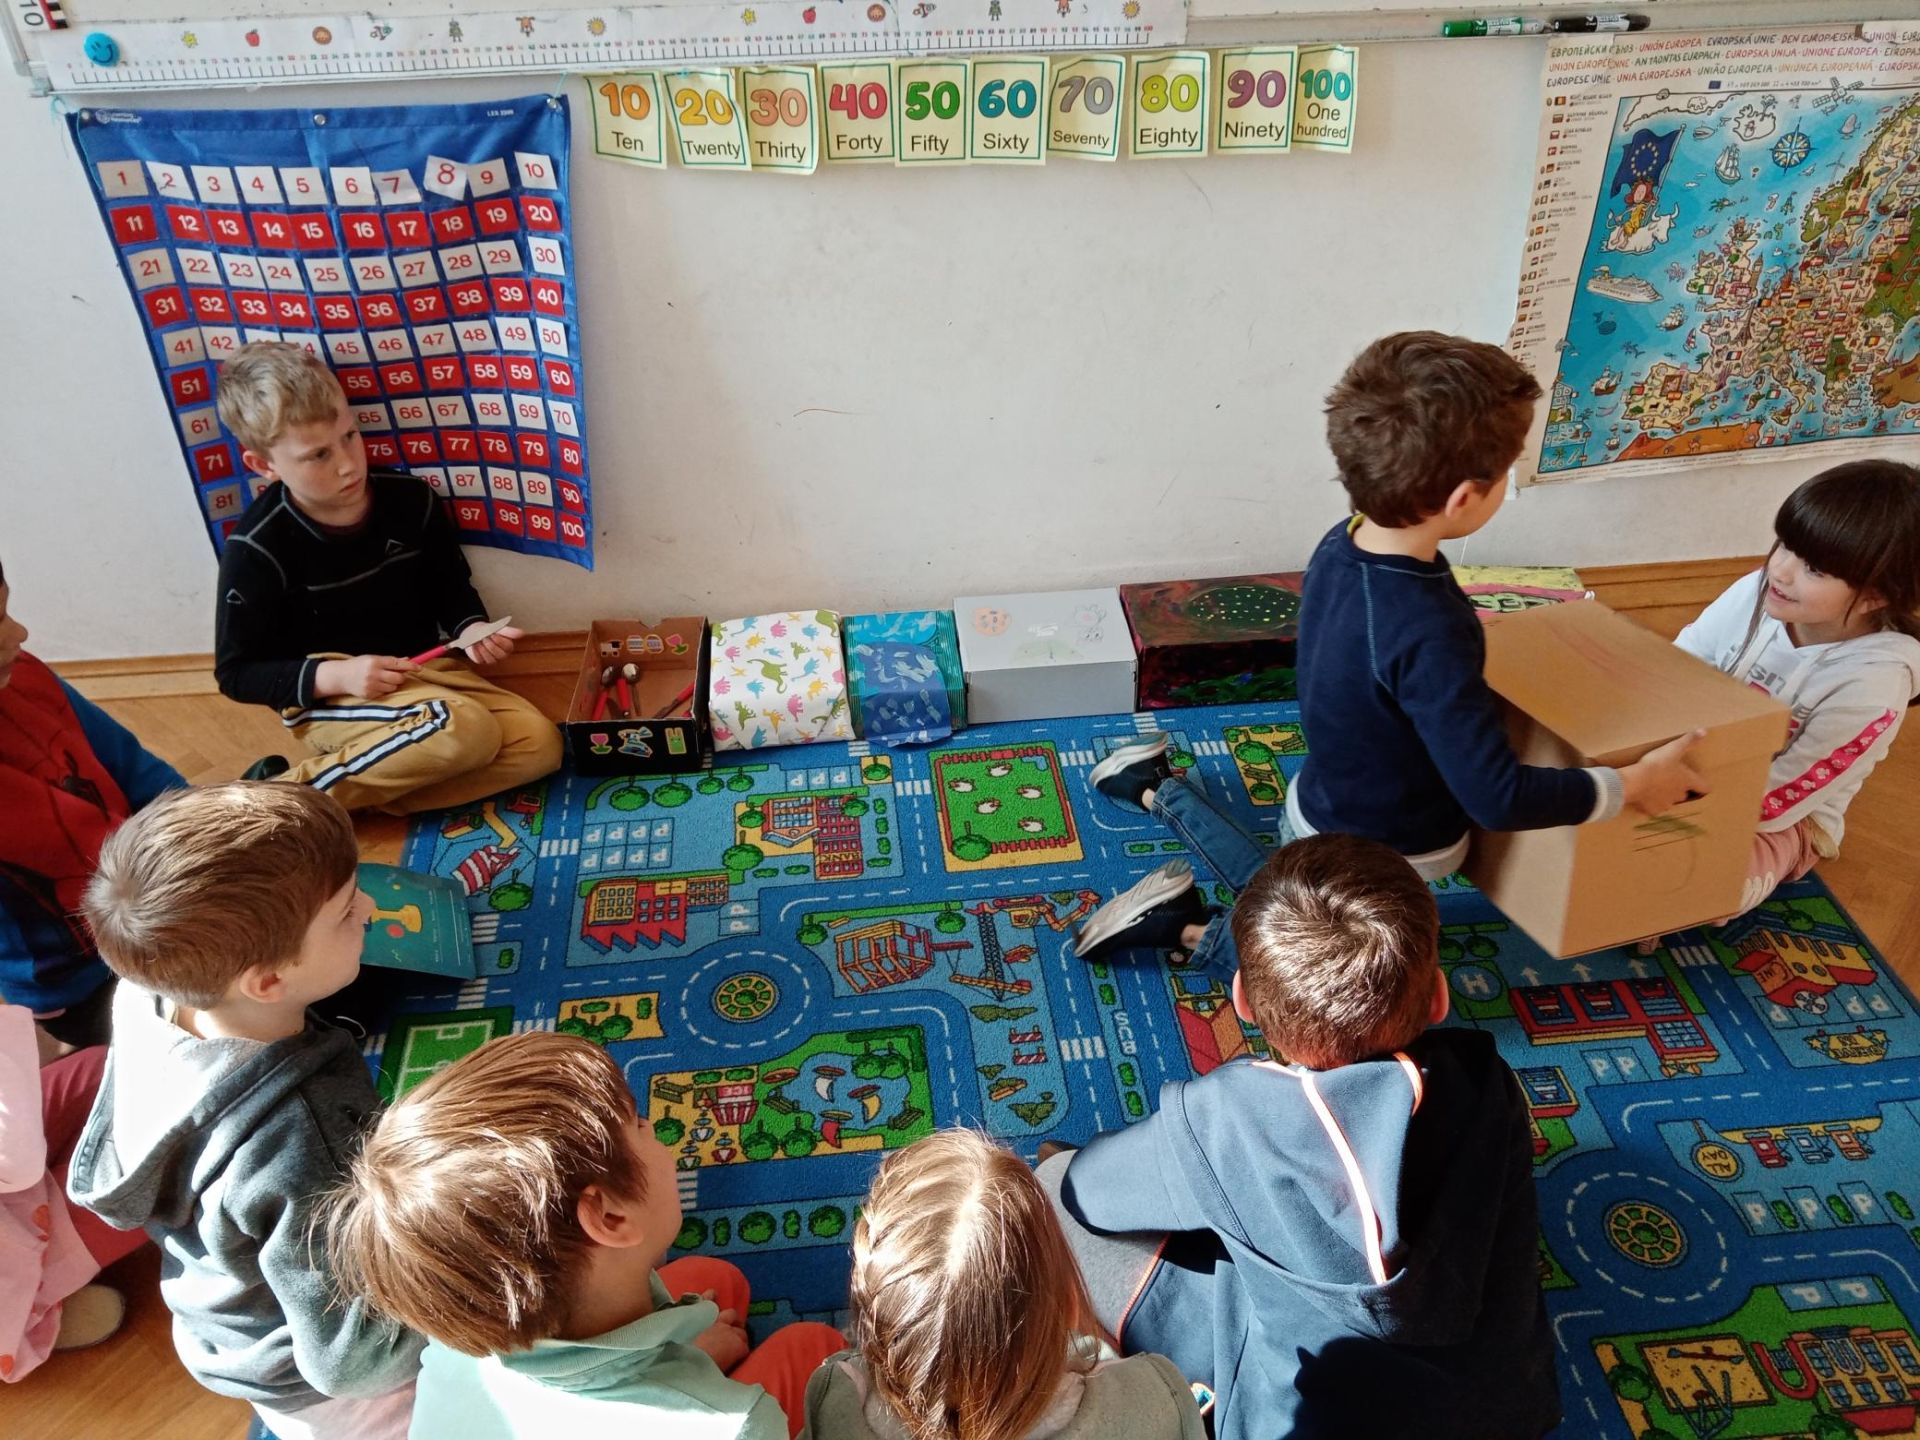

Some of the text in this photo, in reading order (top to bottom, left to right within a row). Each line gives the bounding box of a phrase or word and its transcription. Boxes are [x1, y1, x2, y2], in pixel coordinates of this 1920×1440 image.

[20, 0, 43, 26] 10
[1635, 57, 1647, 67] AN
[978, 80, 1037, 118] 60
[1058, 76, 1114, 115] 70
[1141, 74, 1199, 113] 80
[1228, 70, 1286, 108] 90
[1300, 69, 1351, 101] 100
[600, 82, 650, 120] 10
[675, 88, 733, 125] 20
[750, 88, 807, 126] 30
[829, 82, 888, 120] 40
[905, 81, 960, 120] 50
[1307, 103, 1340, 121] One
[611, 131, 643, 151] Ten
[836, 134, 882, 152] Forty
[911, 135, 949, 155] Fifty
[983, 133, 1029, 153] Sixty
[1053, 130, 1109, 149] Seventy
[1140, 128, 1198, 147] Eighty
[1224, 122, 1284, 141] Ninety
[1297, 123, 1347, 139] hundred
[683, 140, 740, 159] Twenty
[755, 141, 806, 162] Thirty
[118, 163, 544, 194] 1 2 3 4 5 6 7 8 9 10
[126, 205, 552, 239] 11 12 13 14 15 16 17 18 19 20
[140, 247, 556, 282] 21 22 23 24 25 26 27 28 29 30
[155, 286, 558, 319] 31 32 33 34 35 36 37 38 39 40
[174, 338, 194, 354] 41
[210, 336, 233, 350] 42
[335, 342, 359, 355] 45
[377, 338, 403, 352] 46
[422, 333, 445, 346] 47
[463, 329, 487, 342] 48
[505, 327, 527, 341] 49
[542, 329, 561, 345] 50
[181, 364, 570, 395] 51 55 56 57 58 59 60
[191, 403, 572, 433] 61 65 66 67 68 69 70
[204, 438, 579, 471] 71 75 76 77 78 79 80
[215, 494, 233, 509] 81
[456, 474, 475, 487] 87
[493, 476, 513, 490] 88
[527, 480, 546, 495] 89
[563, 486, 580, 502] 90
[461, 508, 583, 537] 97 98 99 100
[1459, 973, 1490, 994] H
[1114, 1011, 1137, 1055] BUS
[723, 1085, 752, 1096] ICE
[1702, 1149, 1729, 1160] DAY
[1706, 1163, 1731, 1173] ALL
